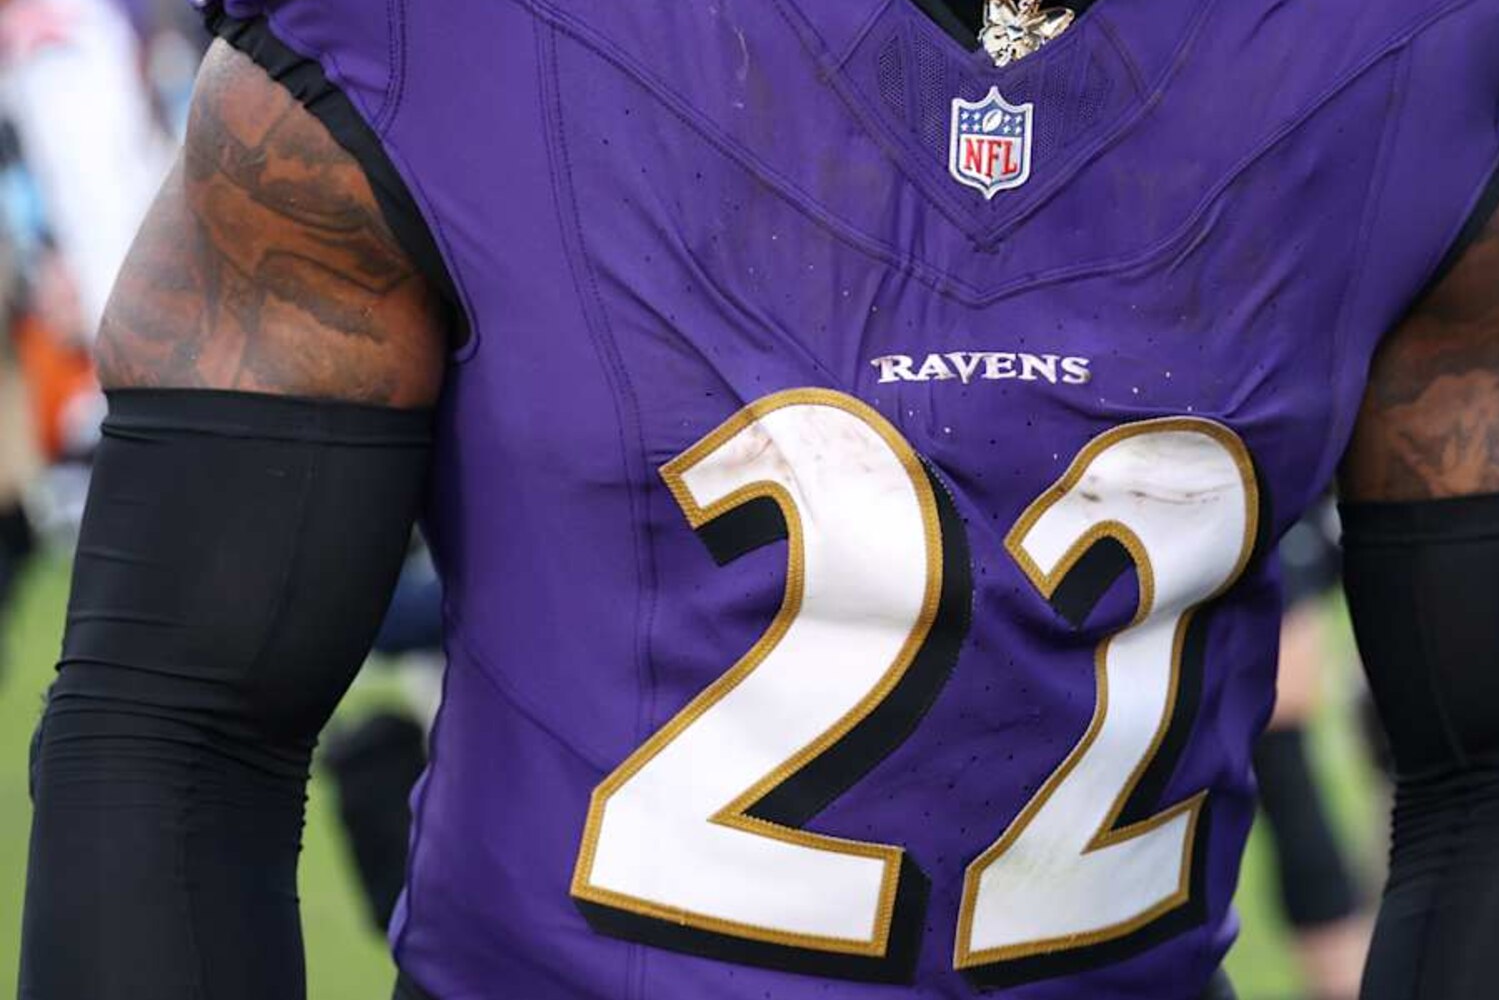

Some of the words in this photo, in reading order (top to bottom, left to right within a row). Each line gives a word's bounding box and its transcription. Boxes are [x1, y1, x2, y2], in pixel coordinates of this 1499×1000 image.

[963, 137, 1018, 178] NFL
[870, 351, 1092, 384] RAVENS
[570, 387, 1264, 976] 22
